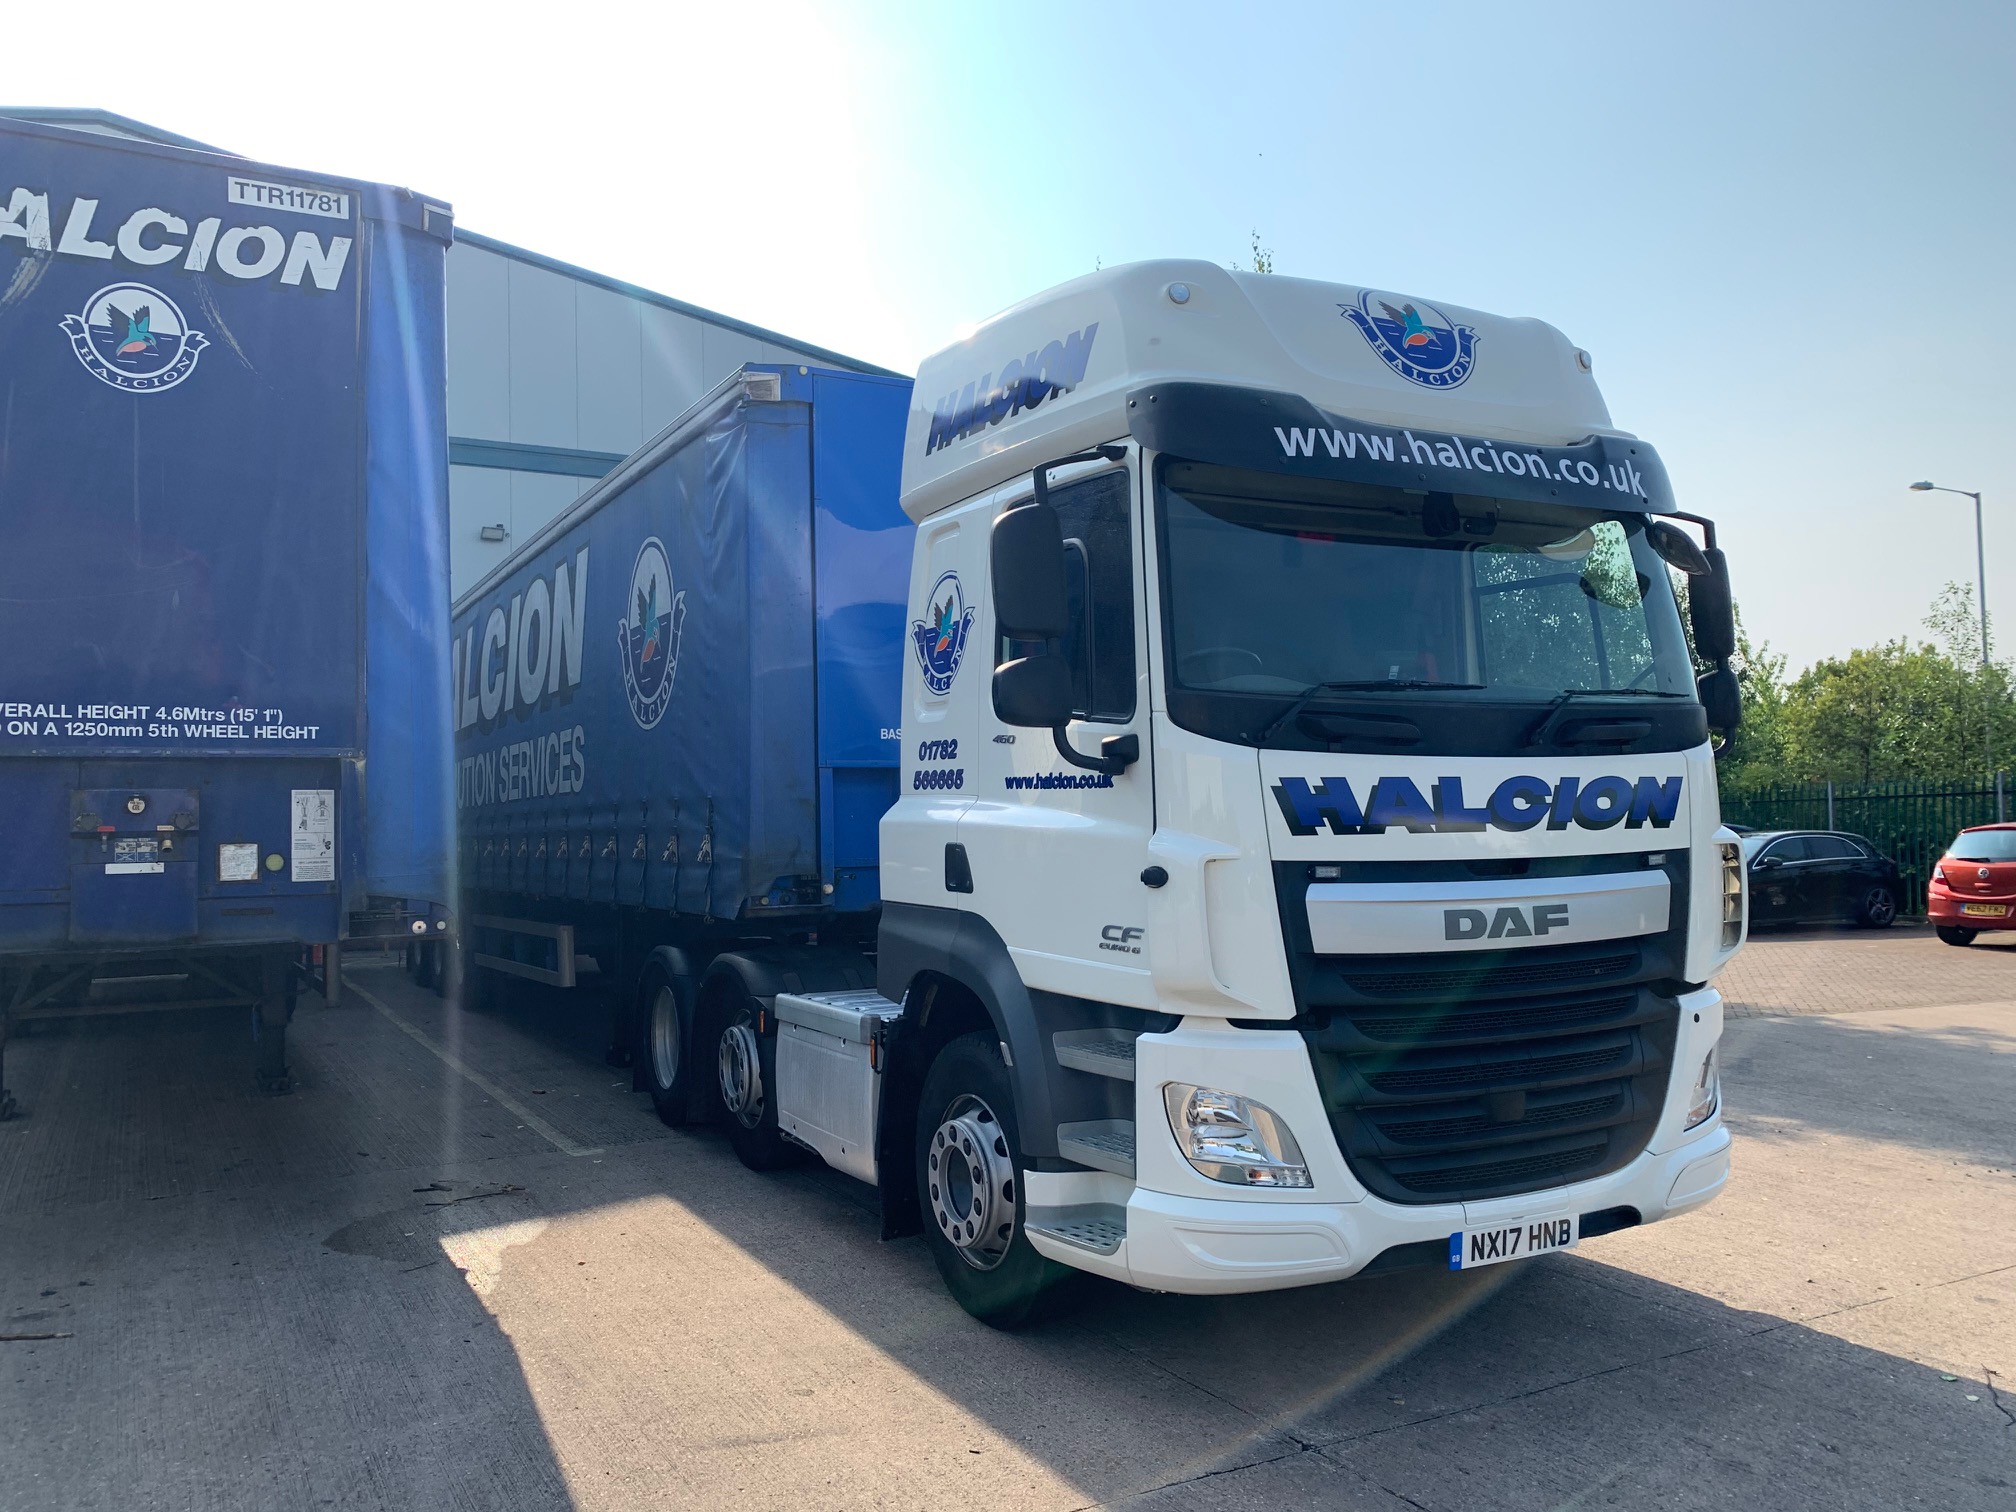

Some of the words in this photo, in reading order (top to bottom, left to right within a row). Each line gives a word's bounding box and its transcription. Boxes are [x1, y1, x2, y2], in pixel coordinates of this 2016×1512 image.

[234, 181, 342, 214] TTR11781
[78, 345, 191, 389] HALCION
[1372, 337, 1472, 385] HALCION
[925, 321, 1099, 457] HALCION
[1273, 426, 1648, 499] www.halcion.co.uk
[625, 651, 676, 722] HALCION
[7, 720, 38, 736] ON
[43, 721, 59, 736] A
[64, 721, 144, 738] 1250mm
[148, 723, 179, 738] 5th
[184, 724, 250, 739] WHEEL
[254, 725, 320, 740] HEIGHT
[77, 704, 151, 720] HEIGHT
[155, 706, 226, 722] 4.6Mtrs
[918, 738, 958, 762] 01782
[992, 734, 1016, 745] 460
[498, 724, 585, 803] SERVICES
[1004, 771, 1115, 790] www.halcion.co.uk
[1270, 775, 1684, 836] HALCION
[1101, 924, 1145, 943] CF
[1444, 904, 1569, 941] DAF
[1470, 1226, 1523, 1262] NX17
[1528, 1218, 1572, 1252] HNB
